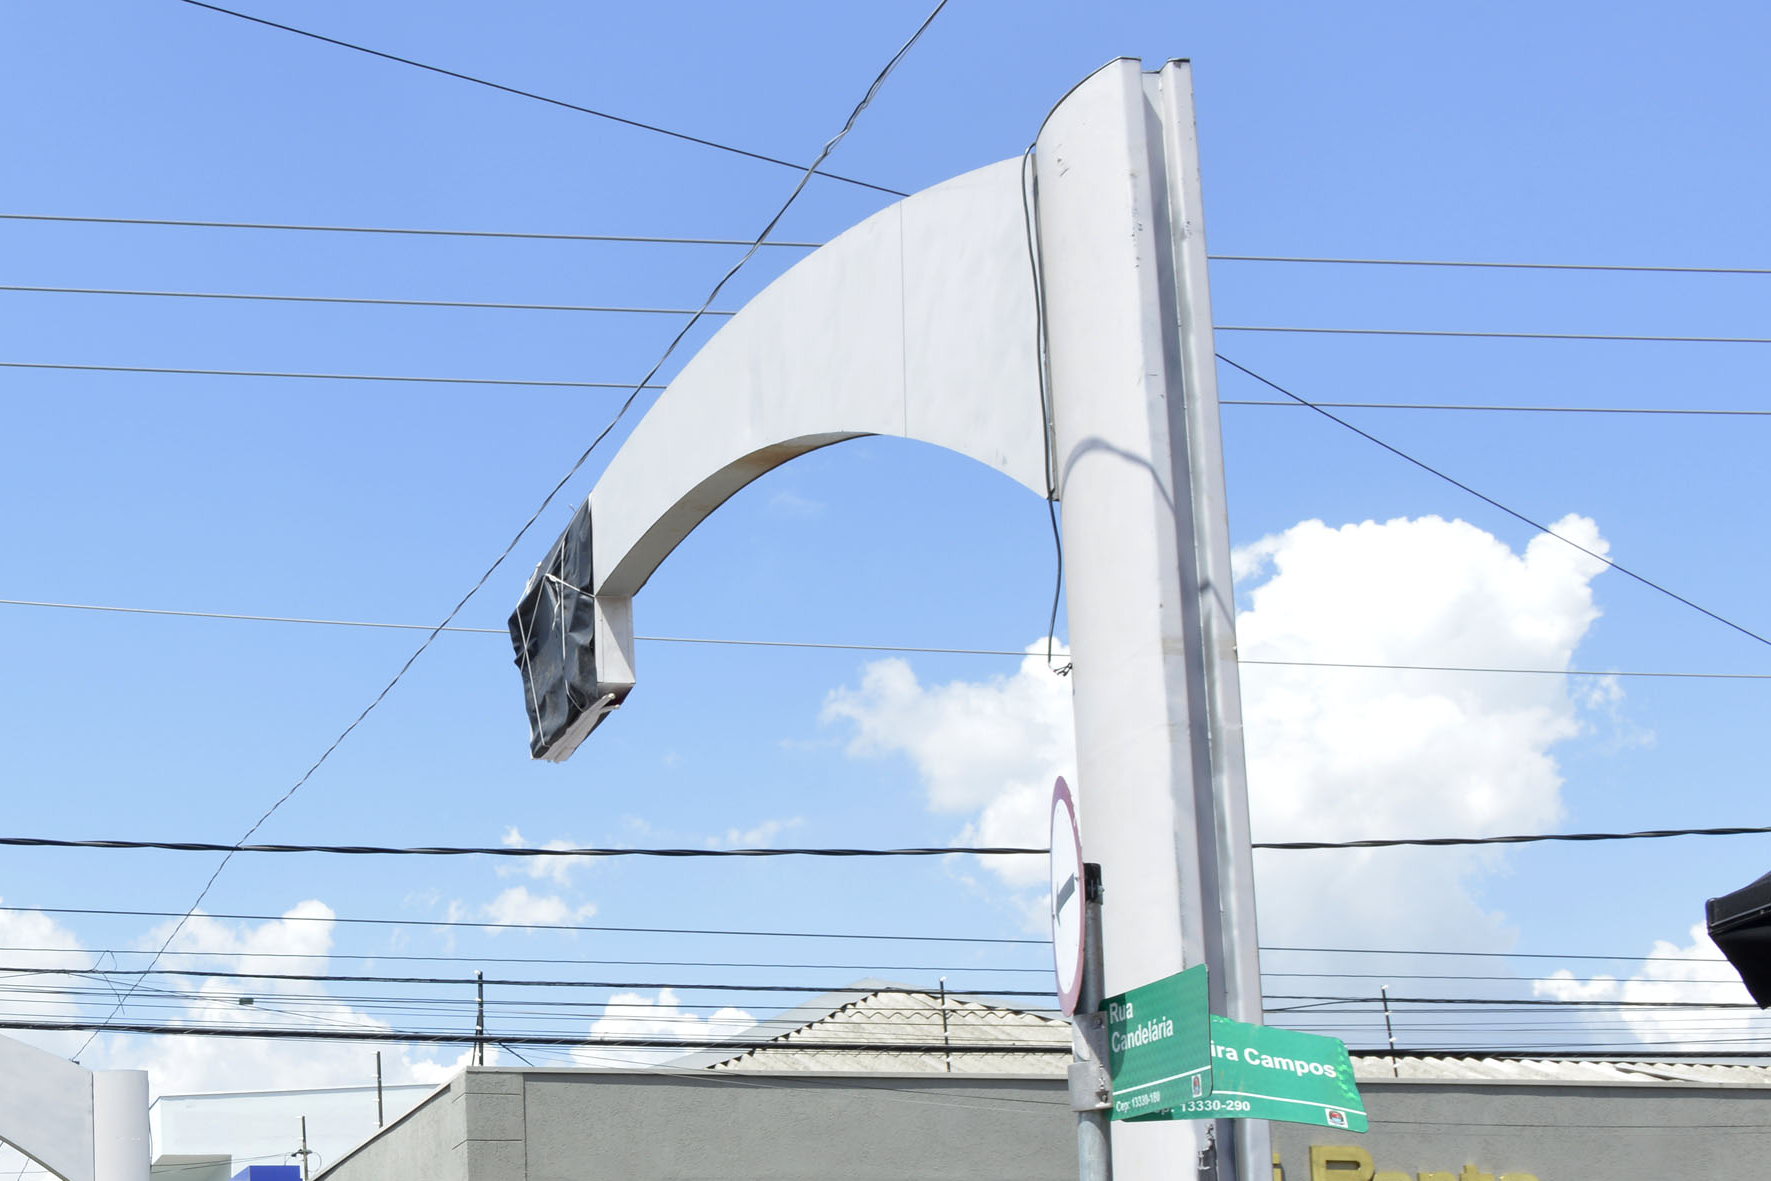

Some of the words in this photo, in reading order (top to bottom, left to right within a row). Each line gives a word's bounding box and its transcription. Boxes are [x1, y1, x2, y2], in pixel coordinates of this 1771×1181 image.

[1109, 1001, 1133, 1024] Rua
[1111, 1016, 1174, 1053] Candelária
[1244, 1047, 1337, 1079] Campos
[1181, 1100, 1251, 1113] 13330-290
